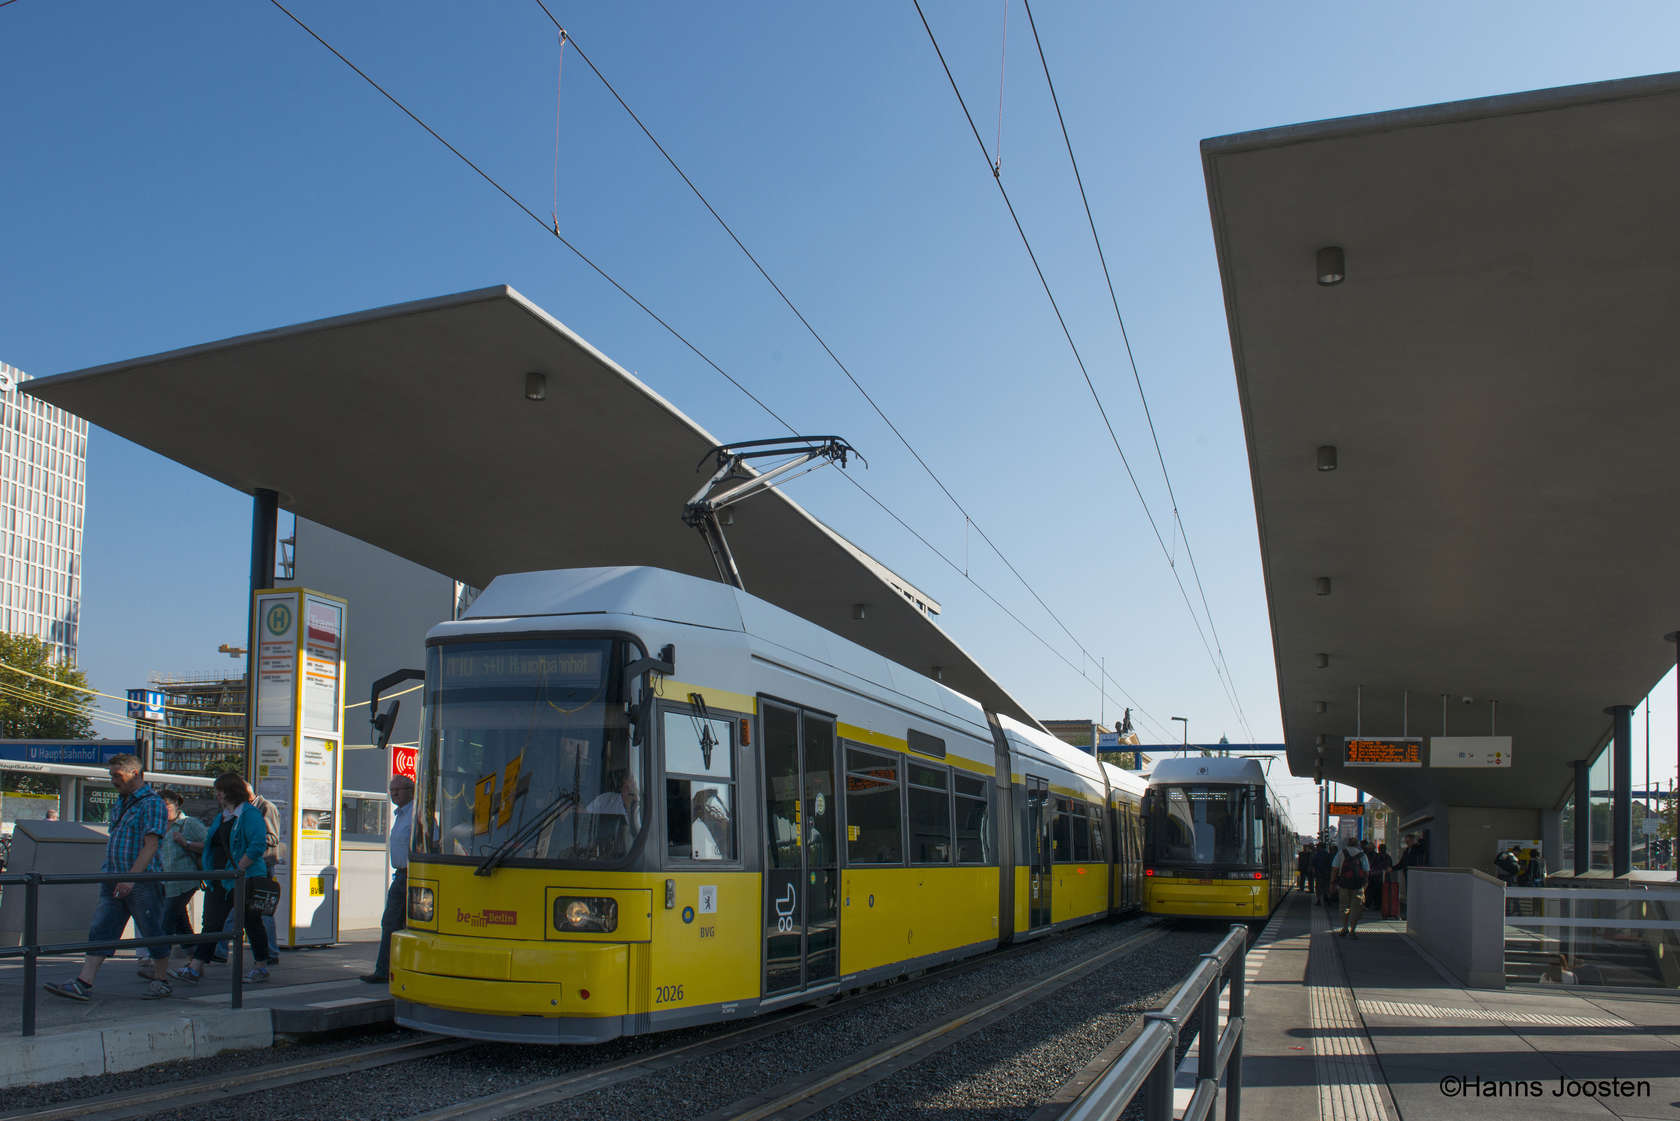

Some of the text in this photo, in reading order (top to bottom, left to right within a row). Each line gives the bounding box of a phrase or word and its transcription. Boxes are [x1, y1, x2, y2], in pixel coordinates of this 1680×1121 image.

[149, 693, 161, 711] U
[31, 748, 96, 760] U Hauptbahnhof
[700, 927, 715, 938] BVG
[656, 985, 684, 1003] 2026
